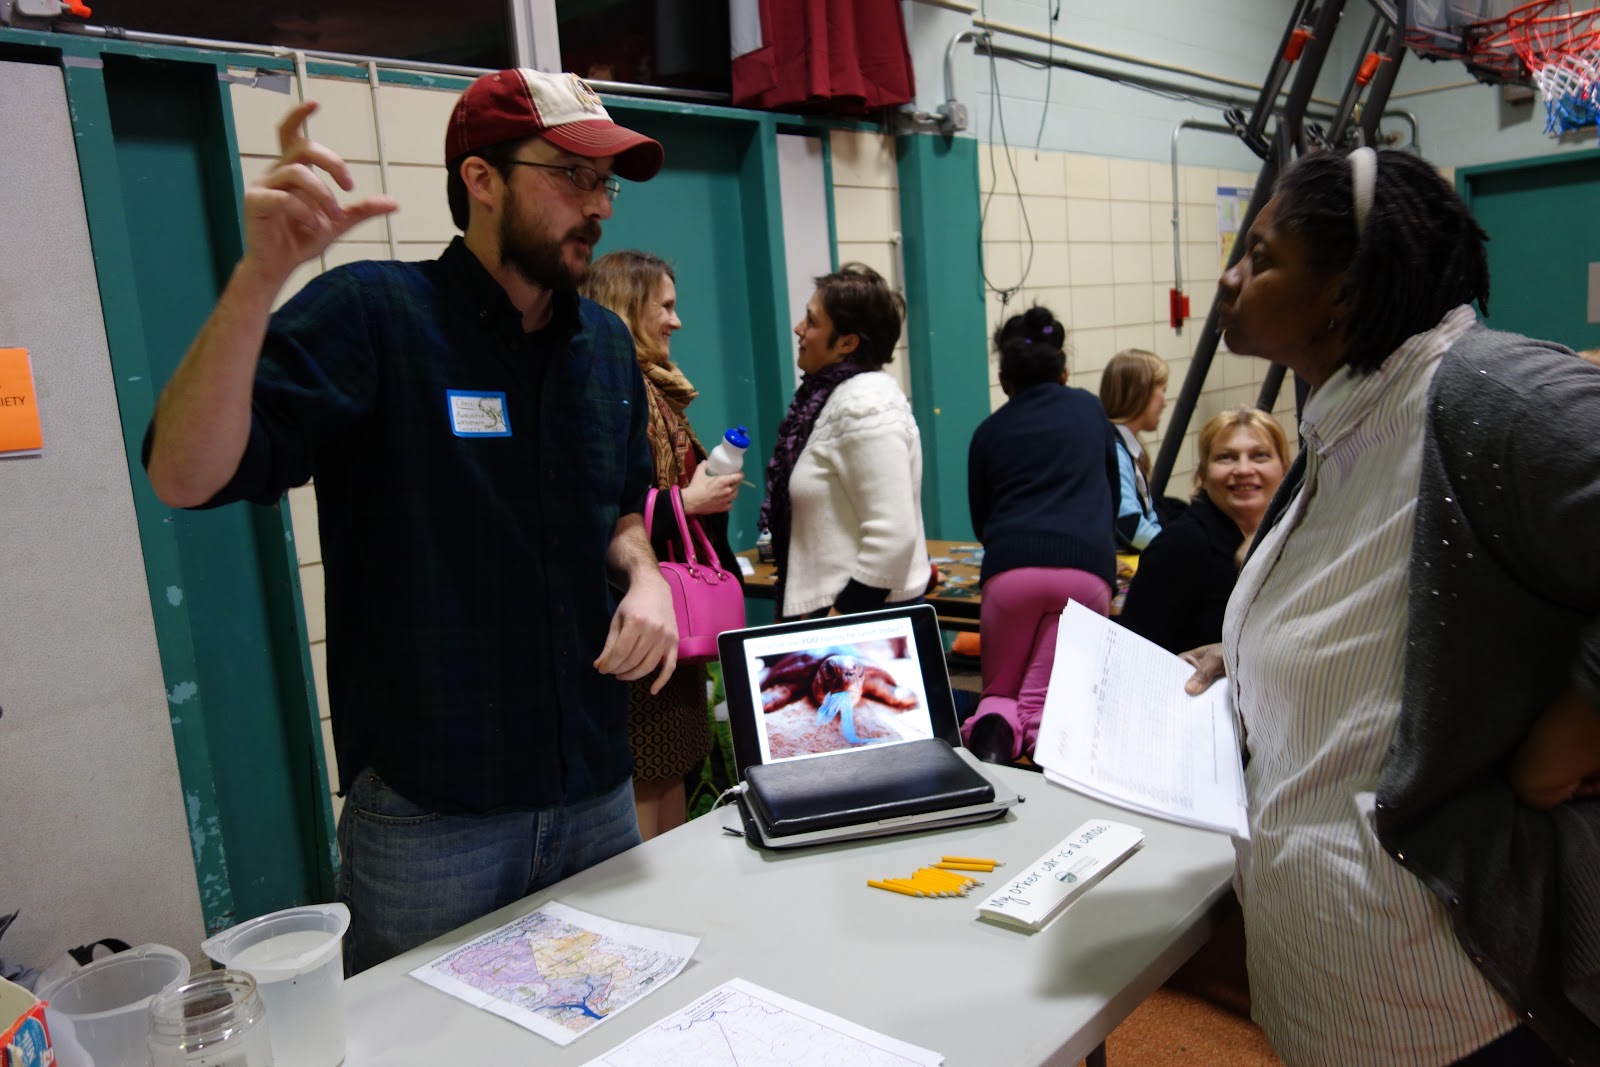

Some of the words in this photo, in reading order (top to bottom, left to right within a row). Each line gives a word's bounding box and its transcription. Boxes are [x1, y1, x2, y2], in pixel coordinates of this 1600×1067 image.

[0, 395, 25, 407] IETY
[801, 636, 819, 645] YOU
[1058, 849, 1074, 858] is
[1041, 858, 1061, 872] car
[1008, 871, 1042, 894] other
[989, 895, 1031, 907] My
